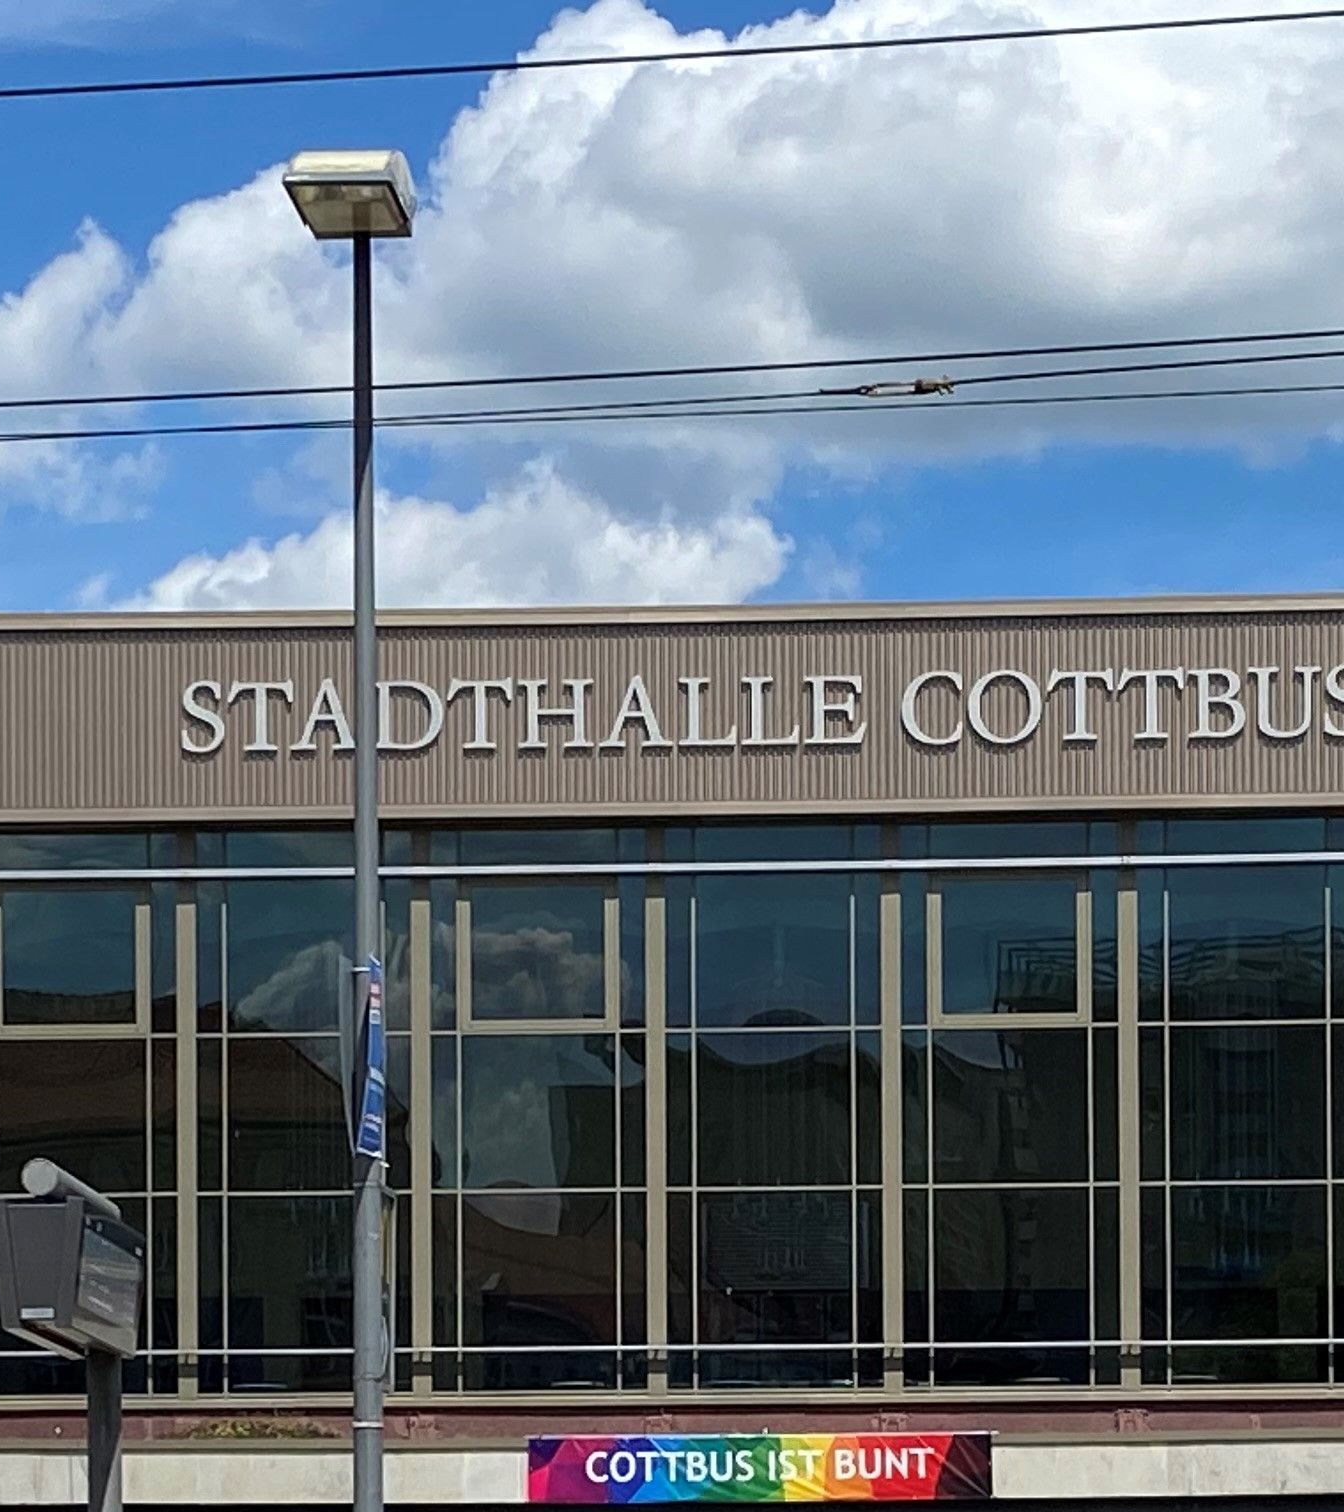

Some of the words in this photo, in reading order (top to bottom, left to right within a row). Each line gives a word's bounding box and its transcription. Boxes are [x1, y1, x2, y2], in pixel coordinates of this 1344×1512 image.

[179, 673, 867, 754] STADTHALLE
[585, 1449, 755, 1483] COTTBUS
[768, 1449, 825, 1481] IST
[833, 1446, 936, 1480] BUNT
